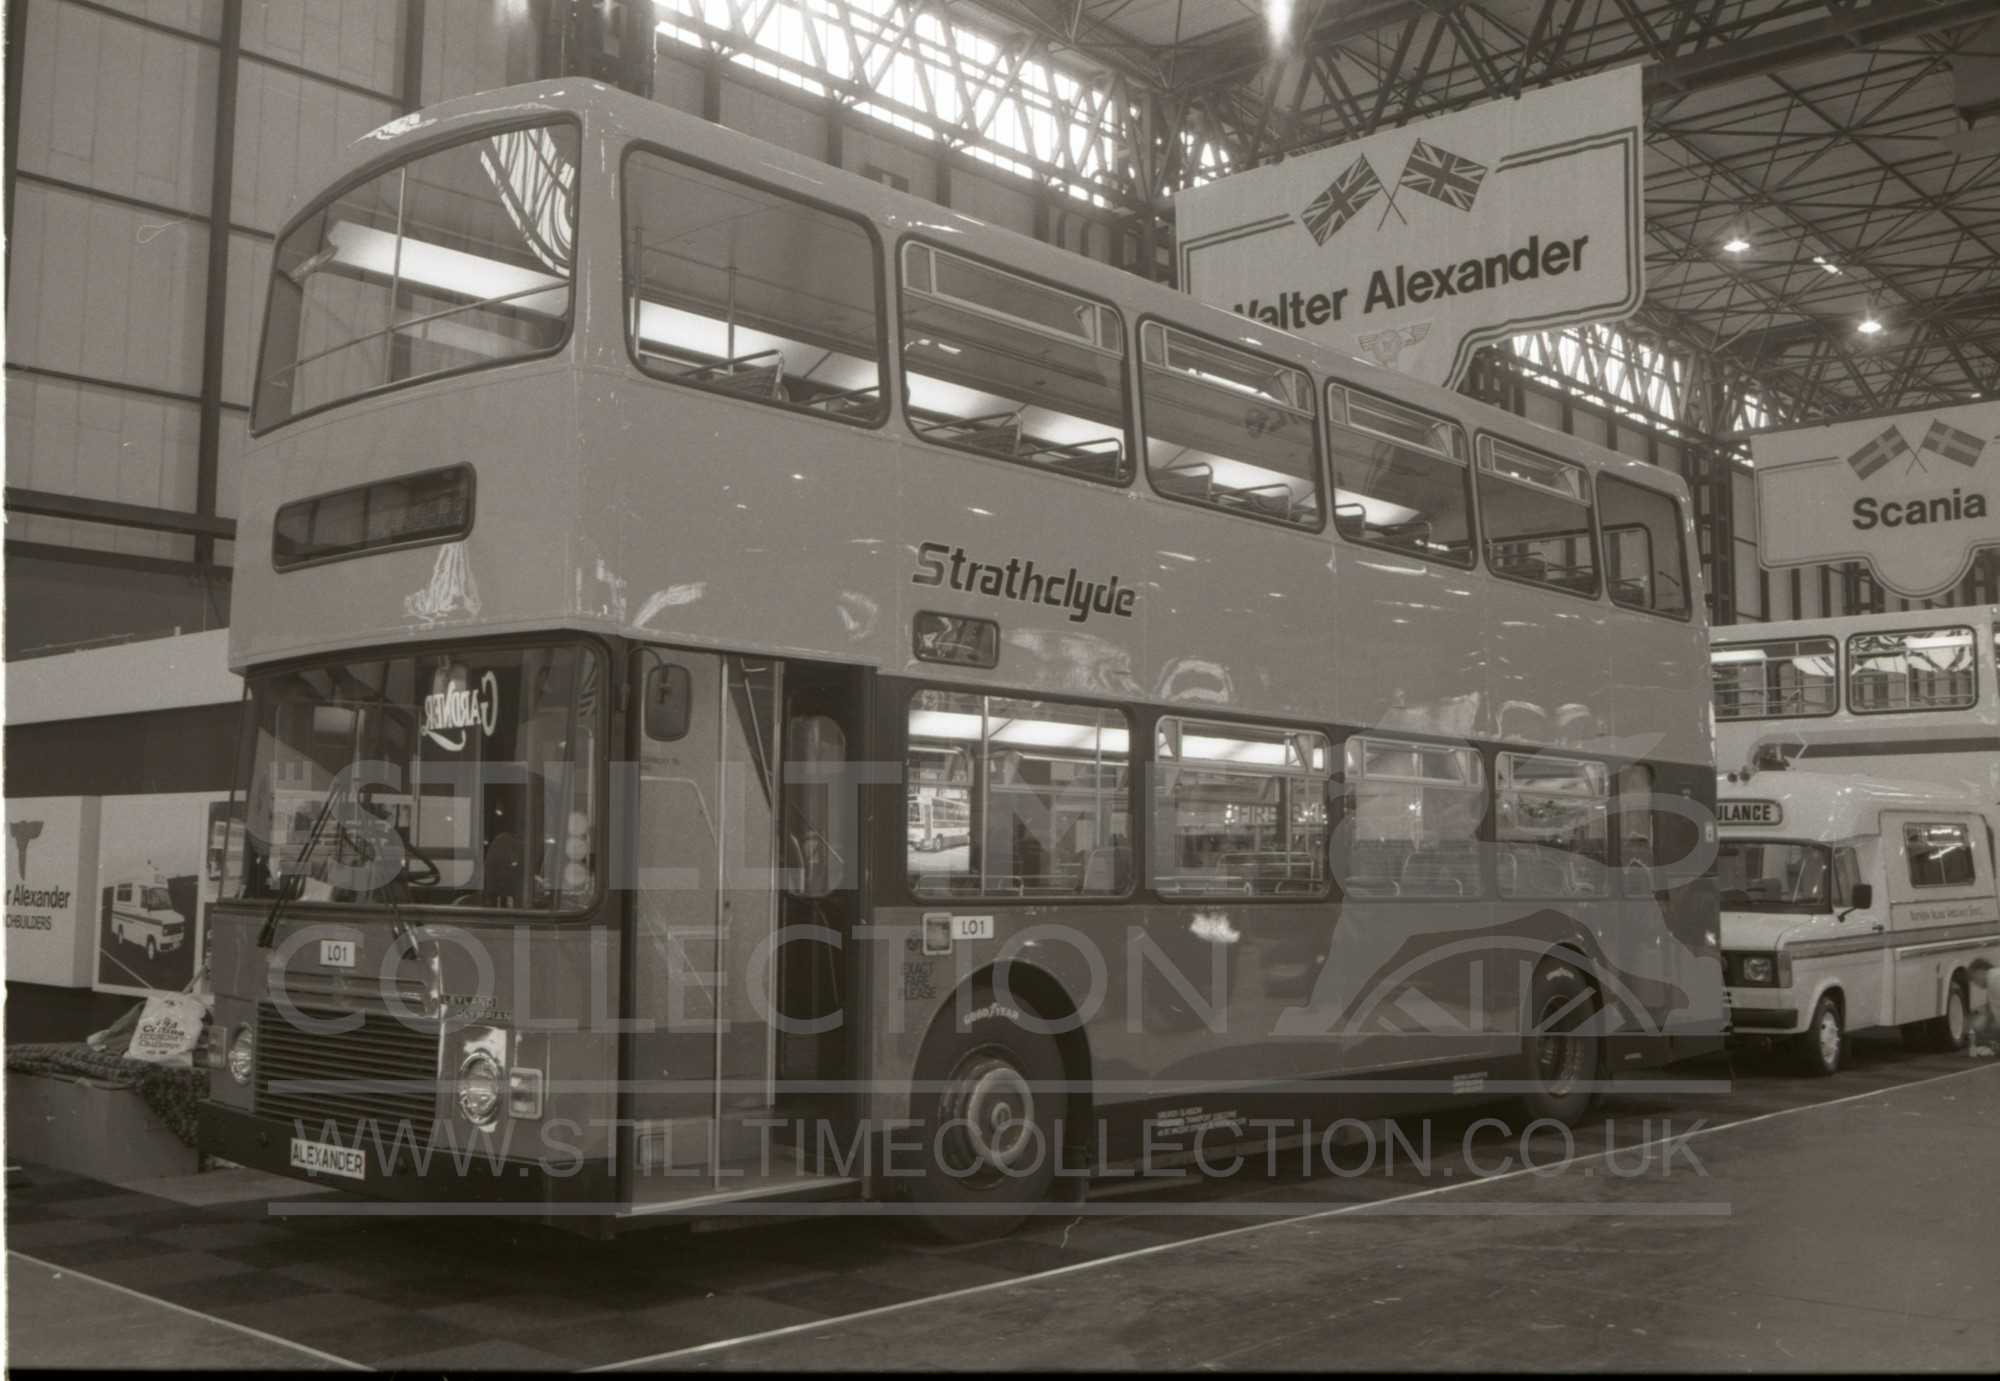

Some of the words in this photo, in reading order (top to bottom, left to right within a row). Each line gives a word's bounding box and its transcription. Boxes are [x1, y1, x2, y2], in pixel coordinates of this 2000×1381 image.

[1363, 234, 1590, 315] Alexander
[1852, 487, 1987, 530] Scania
[912, 541, 1136, 623] Strathclyde
[13, 884, 71, 909] Alexander
[293, 1141, 364, 1174] ALEXANDER
